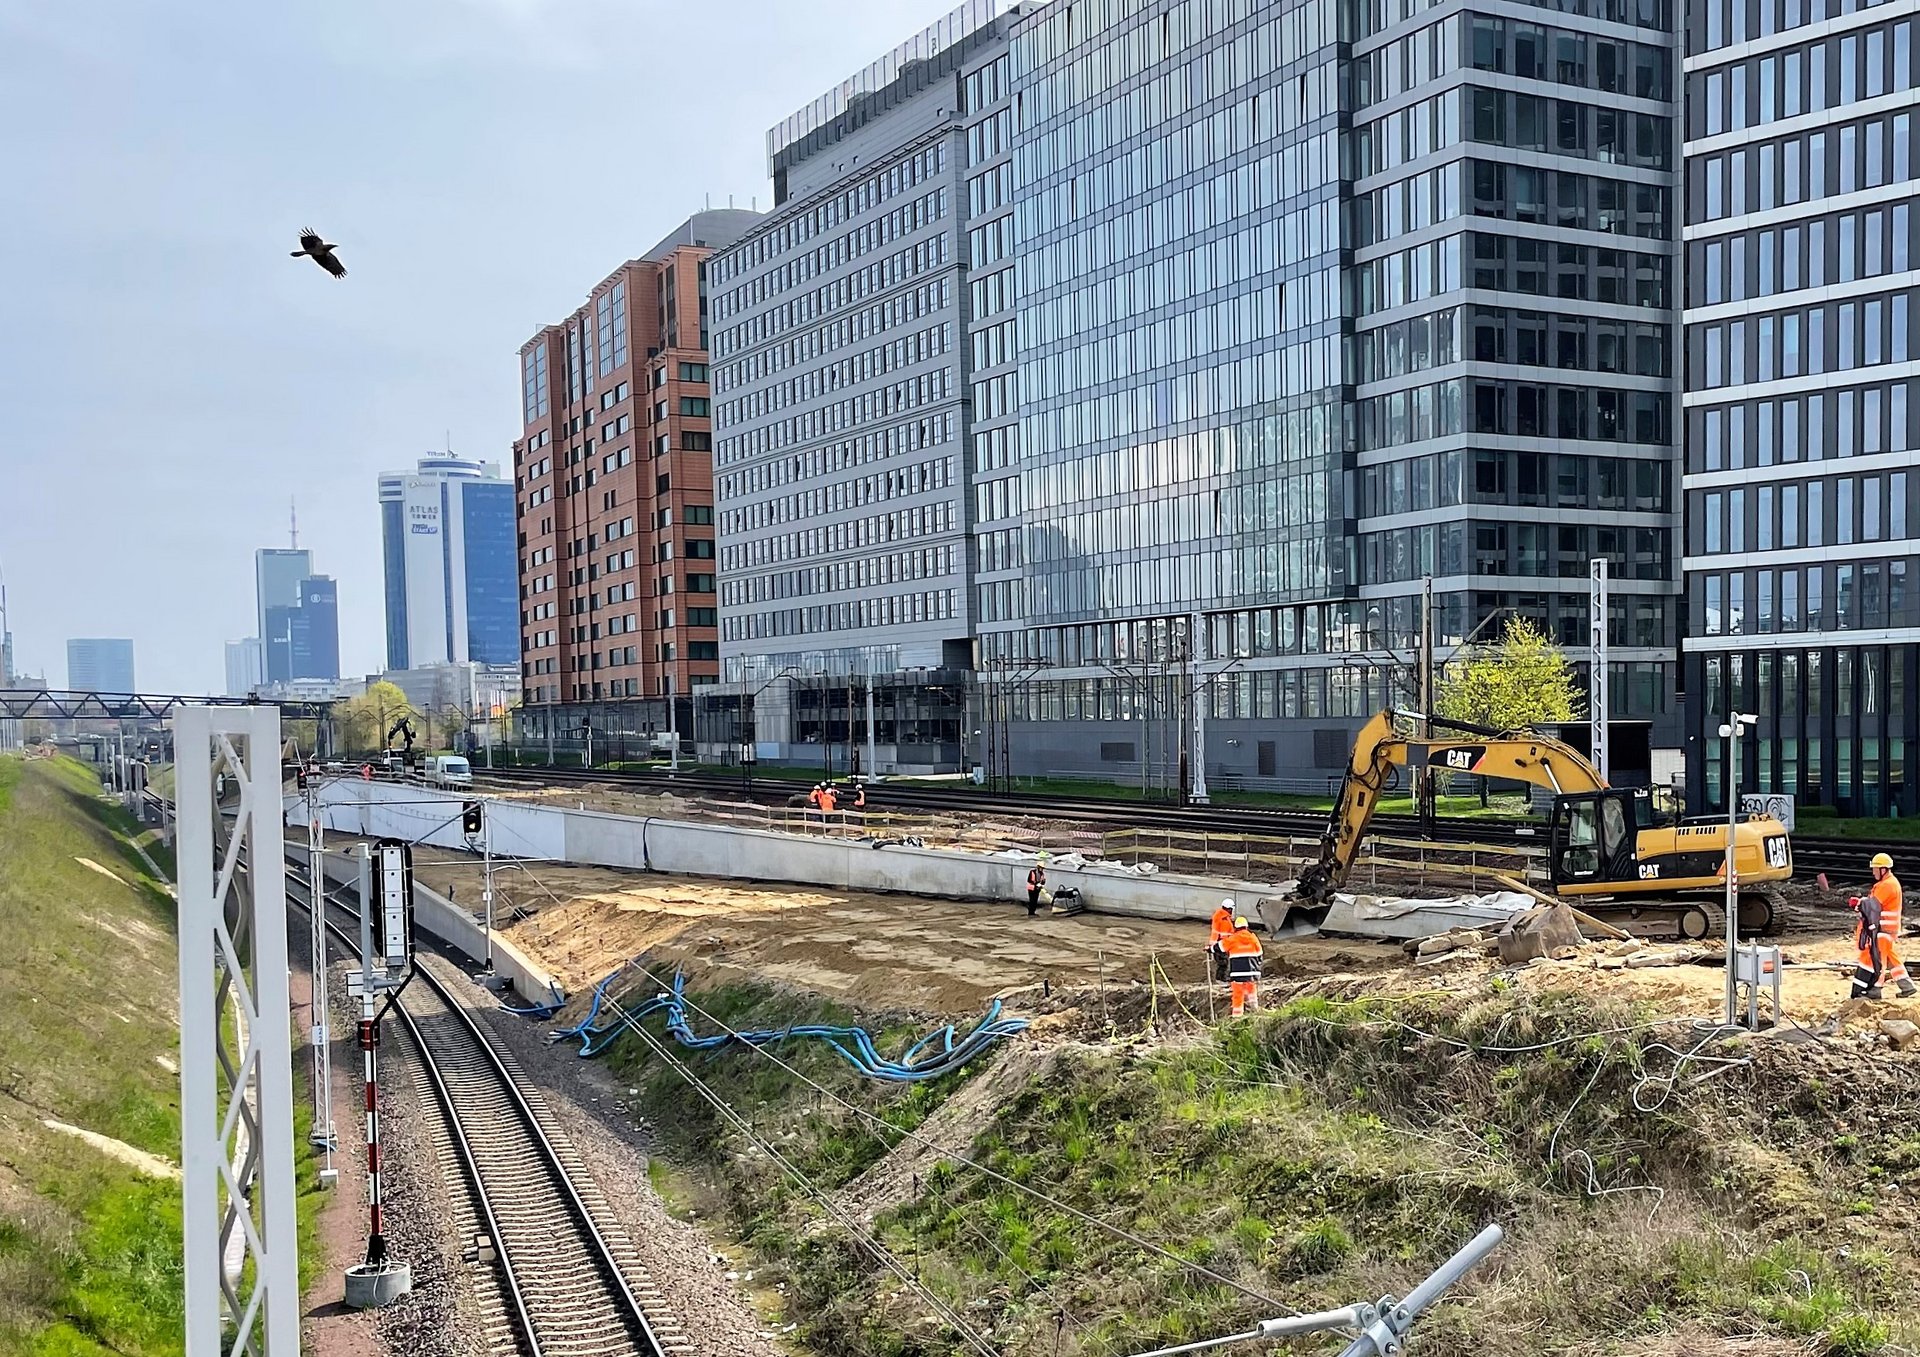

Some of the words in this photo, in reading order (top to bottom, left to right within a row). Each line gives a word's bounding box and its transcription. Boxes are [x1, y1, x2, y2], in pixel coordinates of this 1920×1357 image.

[409, 506, 439, 514] ATLAS
[1446, 749, 1472, 769] CAT
[1768, 838, 1786, 868] CAT
[1639, 864, 1660, 879] CAT
